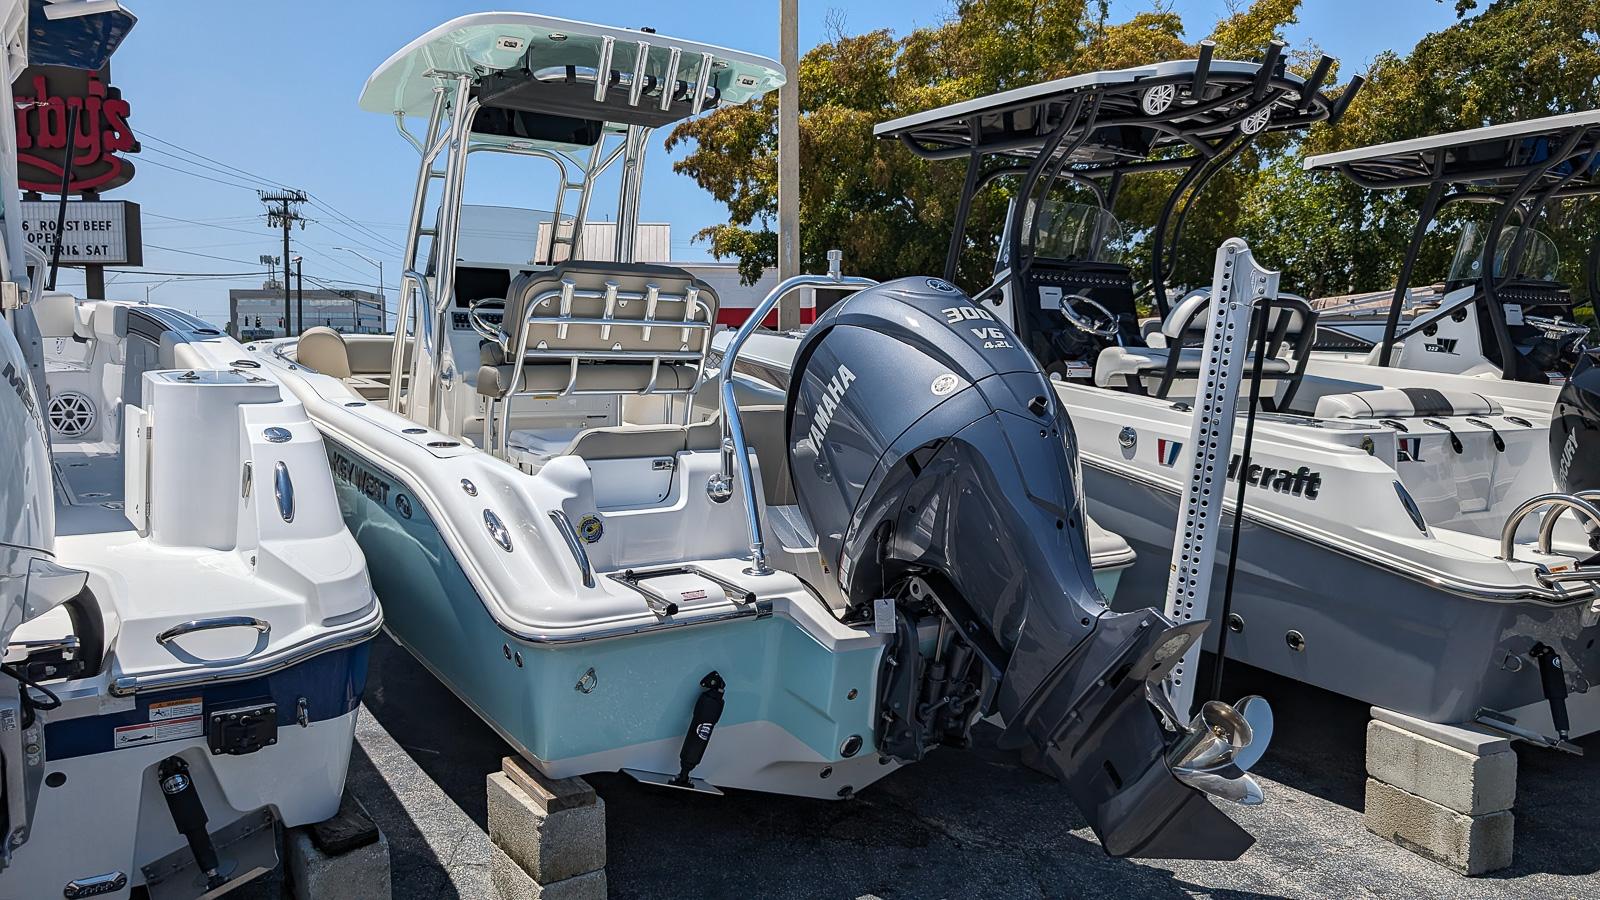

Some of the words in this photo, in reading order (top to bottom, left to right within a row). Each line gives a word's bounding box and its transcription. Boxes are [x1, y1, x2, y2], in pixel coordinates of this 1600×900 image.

[14, 71, 136, 166] rby's
[40, 220, 80, 231] ROST
[83, 220, 112, 231] BEEF
[86, 245, 108, 255] SAT
[942, 306, 995, 324] 300
[971, 327, 1005, 340] V6
[983, 340, 1013, 349] 4.2L
[806, 363, 857, 457] YAMAHA
[331, 451, 355, 487] KEY
[354, 464, 391, 506] WEST
